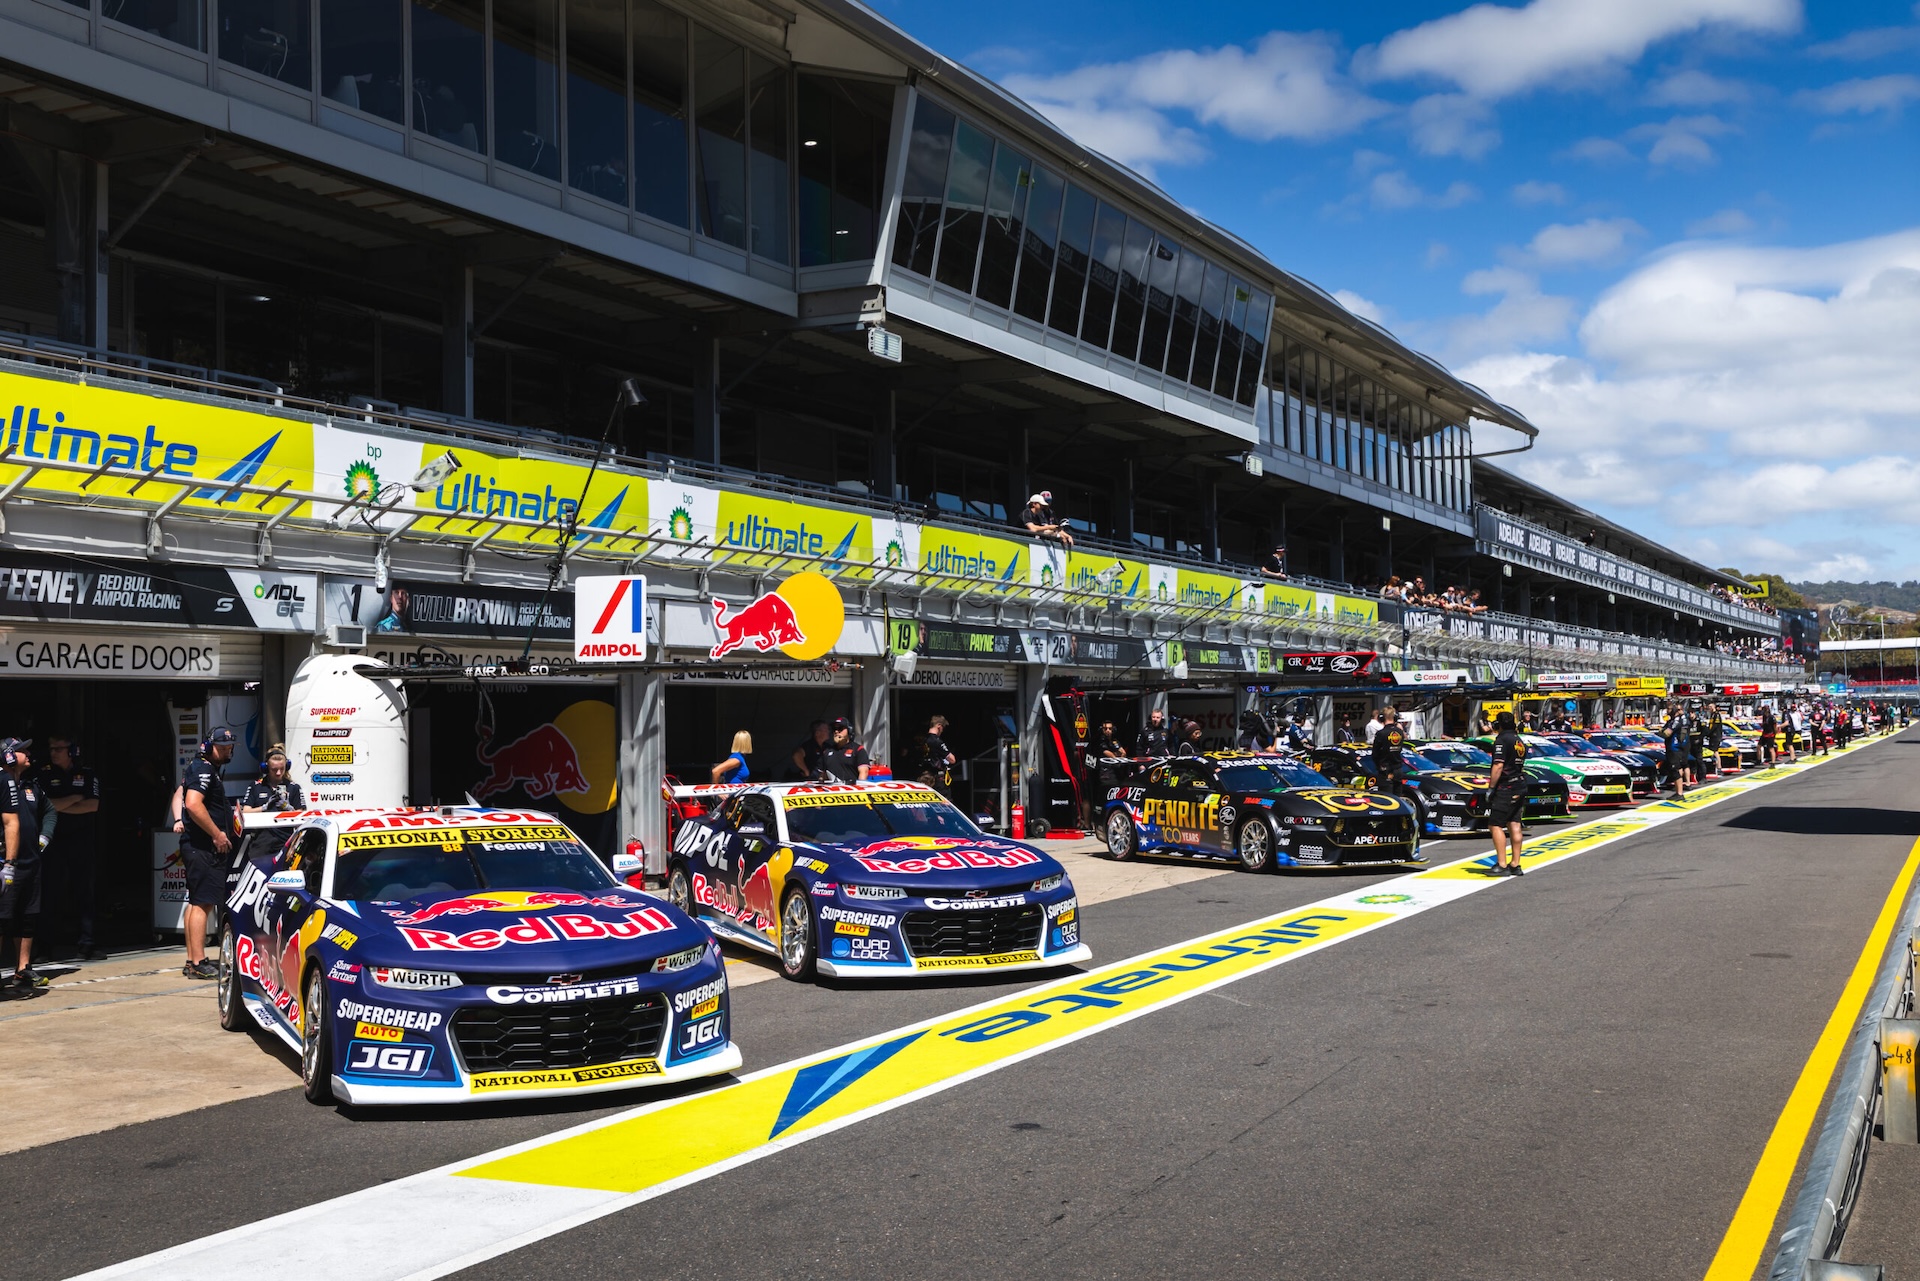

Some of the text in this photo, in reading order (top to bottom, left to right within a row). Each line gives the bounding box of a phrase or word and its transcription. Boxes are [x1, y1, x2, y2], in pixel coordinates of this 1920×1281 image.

[367, 443, 382, 460] bp
[435, 473, 578, 523] ultimate
[728, 514, 823, 556] ultimate
[927, 544, 996, 581] ultimate
[97, 573, 152, 593] RED BULL
[92, 590, 181, 610] AMPOL RACING
[350, 584, 362, 622] 1
[519, 602, 535, 615] RED
[543, 616, 571, 628] RACING
[897, 624, 911, 650] 19
[969, 633, 994, 652] PAYNE
[579, 643, 642, 658] AMPOL
[1052, 636, 1066, 659] 26
[1172, 644, 1178, 664] 6
[15, 641, 214, 673] GARAGE DOORS
[1260, 652, 1269, 668] 55
[1288, 657, 1324, 667] GROVE
[945, 671, 1004, 688] GARAGE DOORS
[310, 708, 356, 716] SUPERCHEAP
[1169, 775, 1179, 787] 19
[785, 792, 940, 807] NATIONAL STORAGE
[1106, 787, 1143, 802] GROVE
[1142, 798, 1220, 831] PENRITE
[1284, 817, 1315, 825] GROVE
[342, 827, 568, 848] NATIONAL STORAGE
[1161, 827, 1200, 844] 100 YEARS
[1353, 833, 1379, 845] APEX
[442, 844, 463, 853] 88
[481, 842, 546, 852] Feeney
[858, 887, 901, 898] WÜRTH
[820, 905, 896, 929] SUPERCHEAP
[396, 908, 678, 951] Red Bull
[838, 923, 866, 934] AUTO
[851, 938, 891, 950] QUAD
[850, 949, 889, 960] LOCK
[917, 953, 1040, 968] NATIONAL STORAGE
[328, 967, 358, 983] Partners
[393, 969, 451, 986] WÜRTH
[938, 915, 1348, 1043] ultimate
[337, 998, 442, 1032] SUPERCHEAP
[694, 1000, 717, 1016] AUTO
[360, 1025, 399, 1038] AUTO
[682, 1016, 721, 1050] JGI
[351, 1046, 426, 1072] JGI
[1895, 1045, 1912, 1064] 48
[473, 1060, 658, 1090] NATIONAL STORAGE
